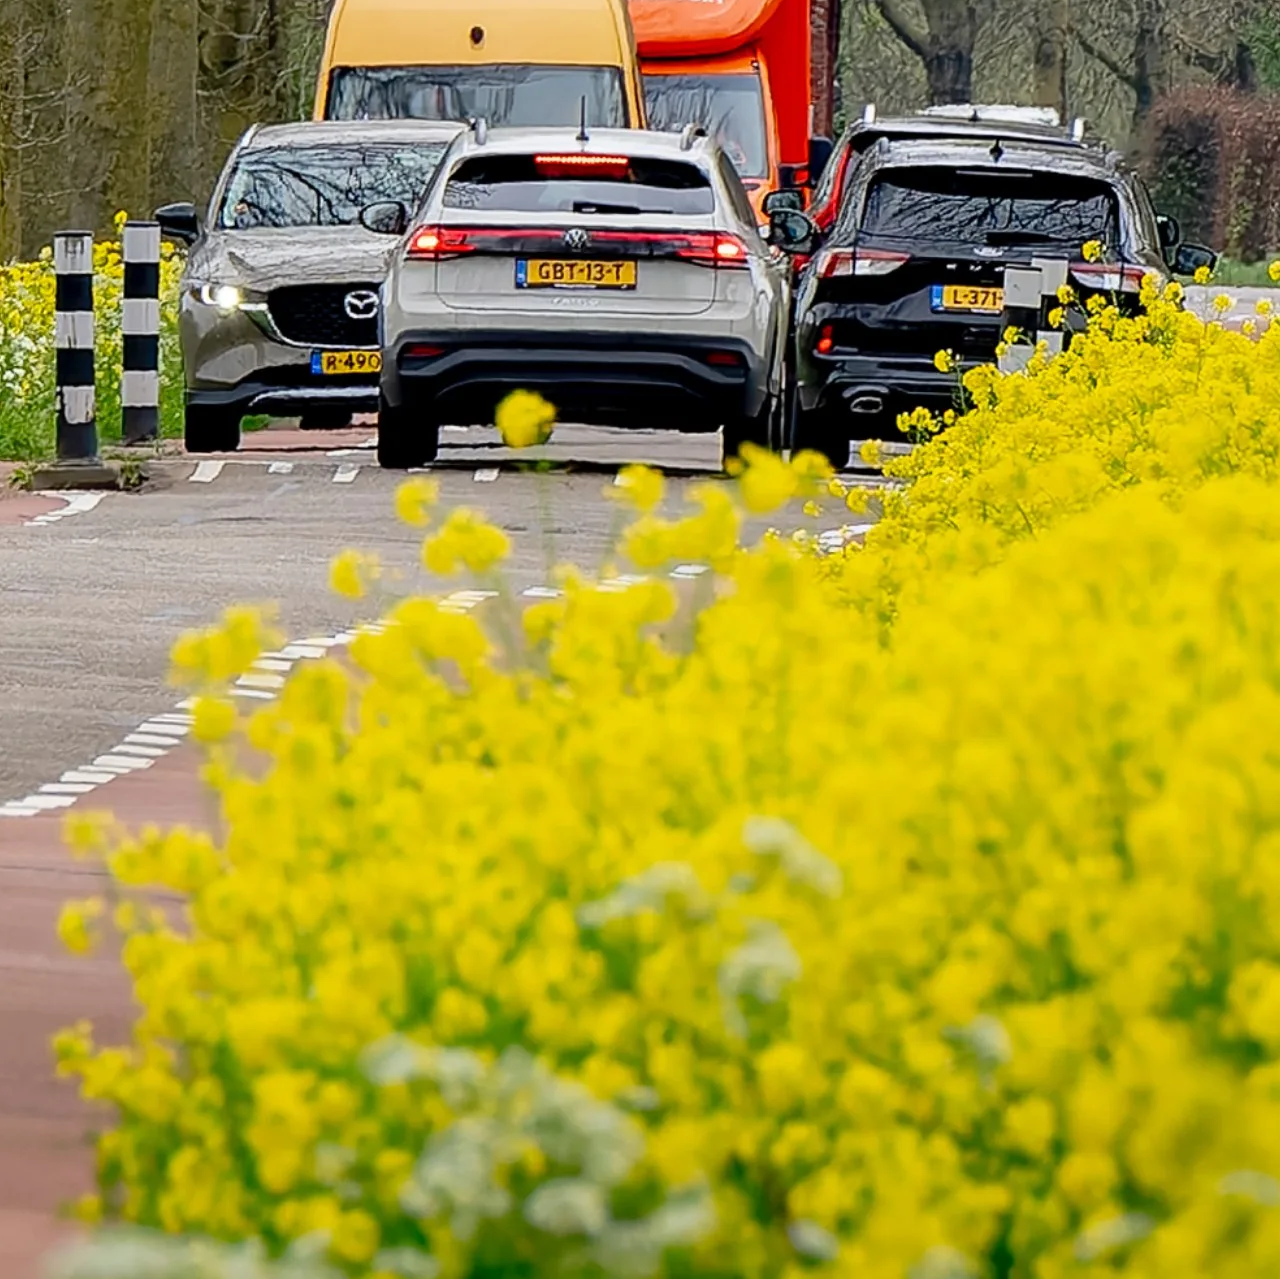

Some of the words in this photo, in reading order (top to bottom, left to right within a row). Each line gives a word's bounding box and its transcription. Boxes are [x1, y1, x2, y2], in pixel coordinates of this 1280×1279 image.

[538, 262, 625, 282] GBT-13-T
[953, 288, 1004, 307] L-371-
[326, 352, 381, 371] R-490
